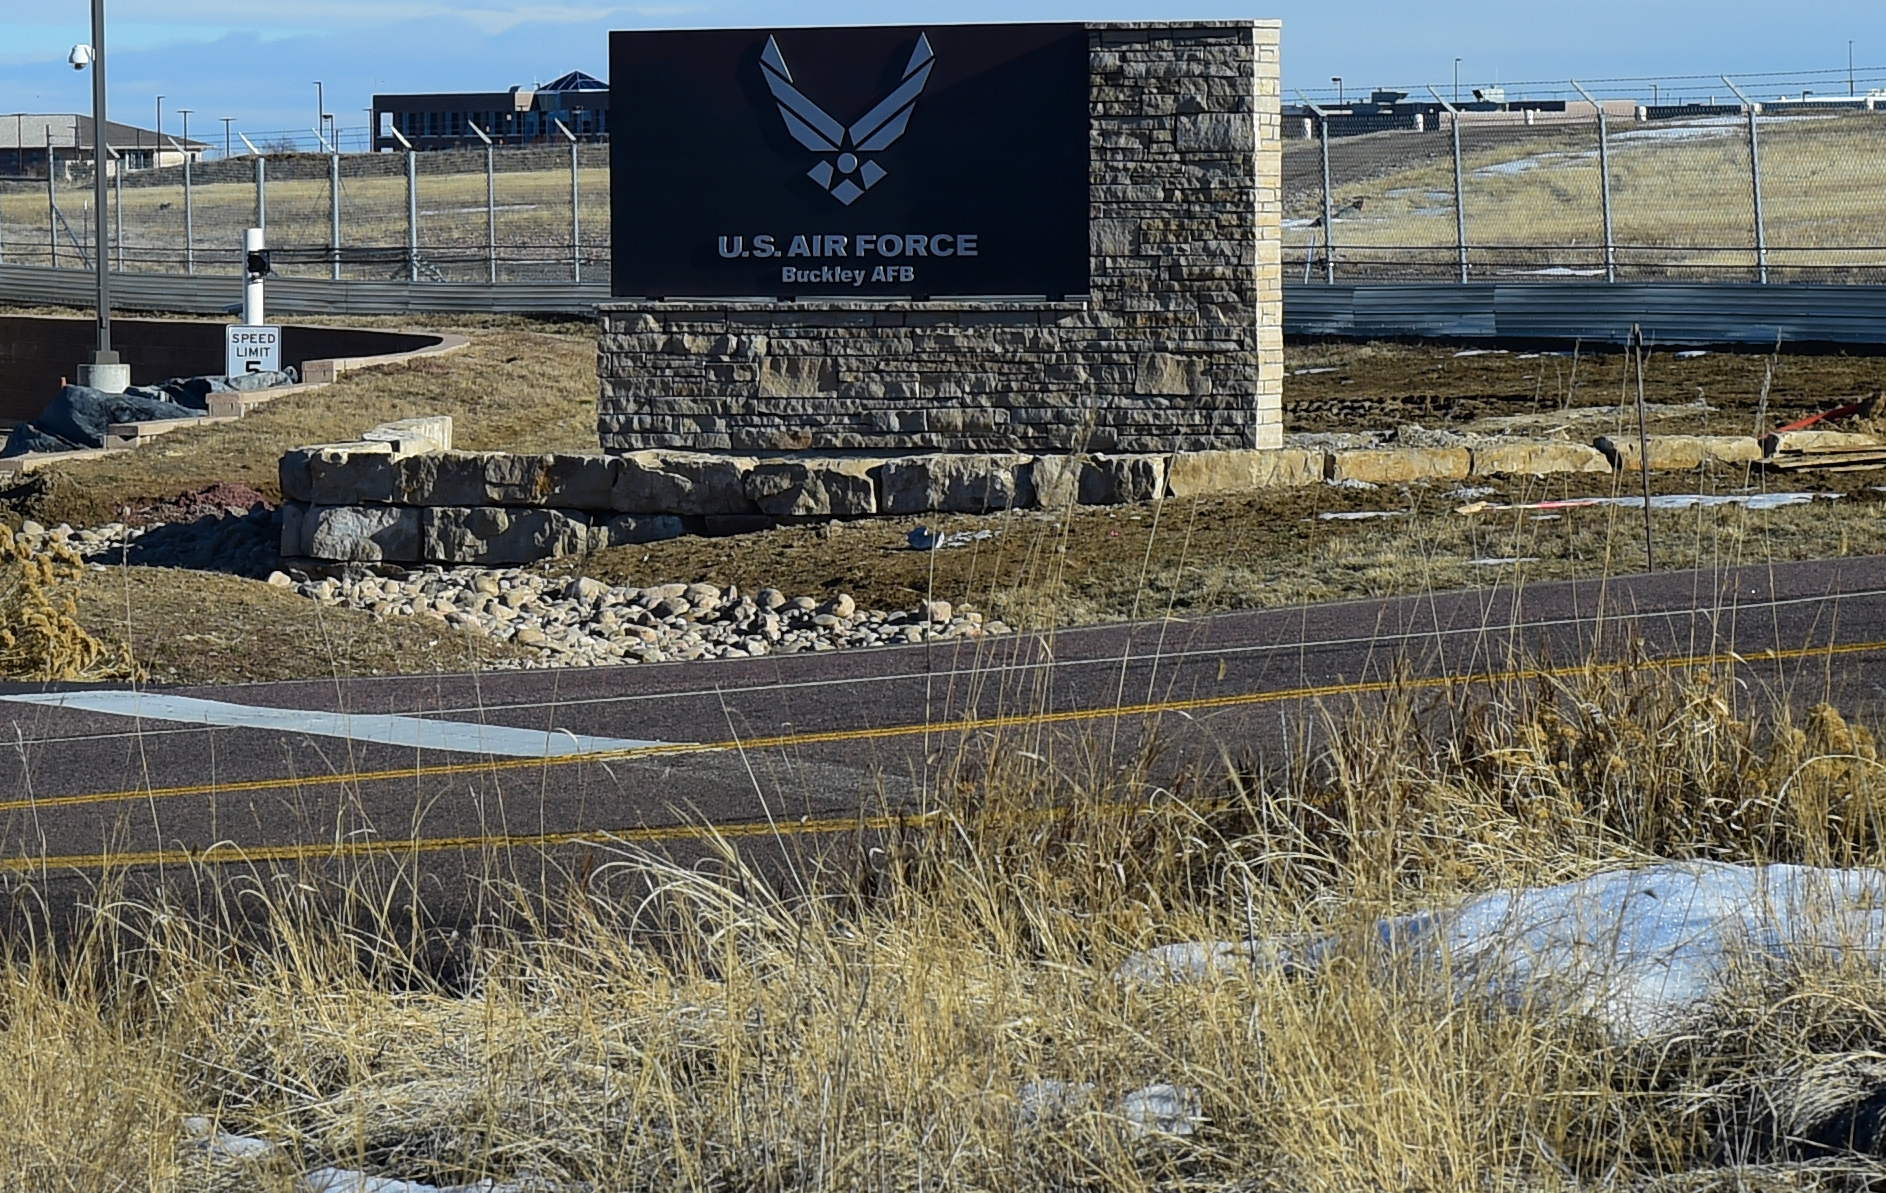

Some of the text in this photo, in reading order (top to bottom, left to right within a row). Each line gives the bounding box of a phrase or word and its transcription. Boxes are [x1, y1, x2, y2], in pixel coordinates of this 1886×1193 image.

[718, 234, 978, 258] U.S. AIR FORCE
[782, 266, 914, 287] Buckley AFB
[231, 333, 276, 343] SPEED
[236, 347, 271, 358] LIMIT
